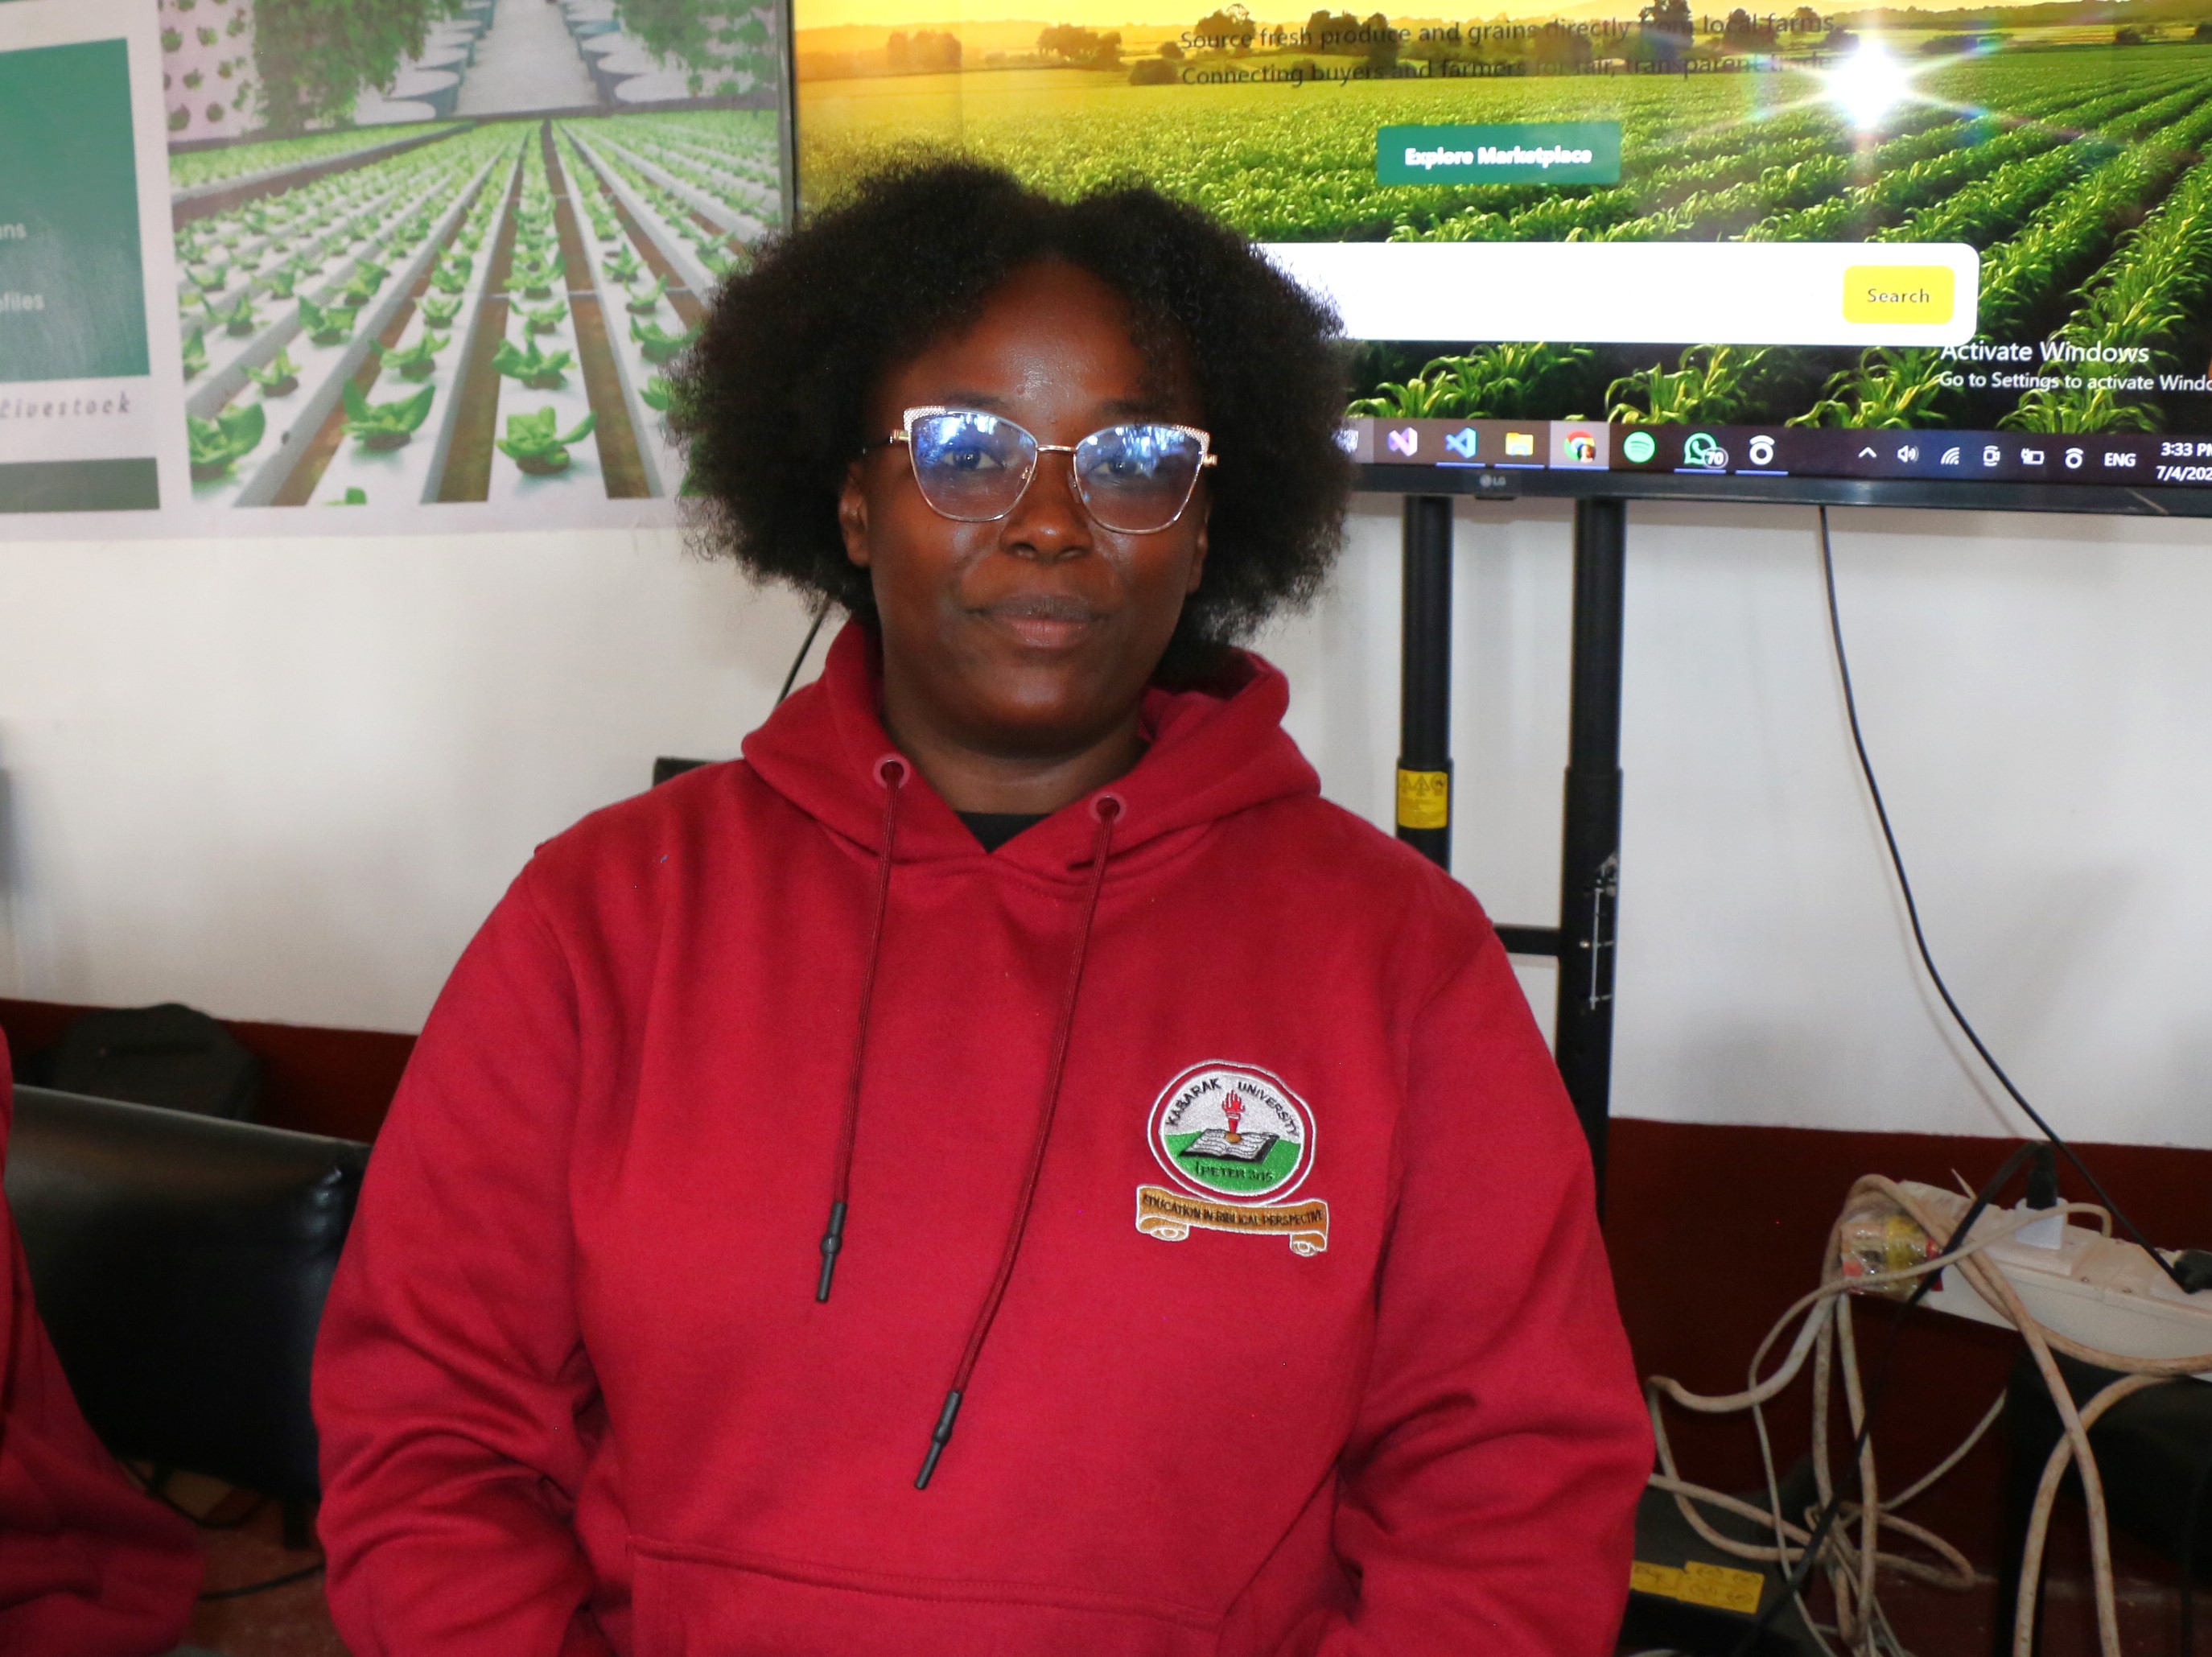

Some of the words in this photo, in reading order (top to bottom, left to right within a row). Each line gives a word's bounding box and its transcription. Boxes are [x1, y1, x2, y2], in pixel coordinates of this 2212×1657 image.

[1180, 31, 1252, 49] Source
[1260, 27, 1312, 47] fresh
[1320, 23, 1411, 49] produce
[1419, 22, 1460, 41] and
[1468, 19, 1539, 46] grains
[1546, 17, 1632, 41] directly
[1703, 14, 1757, 34] local
[1768, 12, 1834, 32] farms
[1182, 64, 1304, 88] Connecting
[1312, 59, 1383, 87] buyers
[1394, 60, 1431, 79] and
[1442, 57, 1527, 77] farmers
[1626, 54, 1761, 80] transparent
[1770, 51, 1833, 72] trde
[1405, 146, 1474, 170] Explore
[1477, 145, 1592, 168] Marketplace
[0, 223, 27, 239] ns
[0, 291, 45, 312] files
[1868, 288, 1930, 303] Search
[1940, 341, 2033, 362] Activate
[2040, 340, 2150, 363] Windows
[1938, 371, 1964, 387] Go
[1968, 373, 1988, 388] to
[1991, 372, 2060, 394] Settings
[2065, 374, 2082, 389] to
[2087, 374, 2155, 390] activate
[1707, 451, 1724, 465] 70
[2104, 452, 2136, 467] ENG
[2161, 442, 2193, 456] 3:33
[1166, 1078, 1221, 1127] KABARAK
[1238, 1081, 1300, 1137] UNIVERSITY
[1201, 1165, 1245, 1178] PETER
